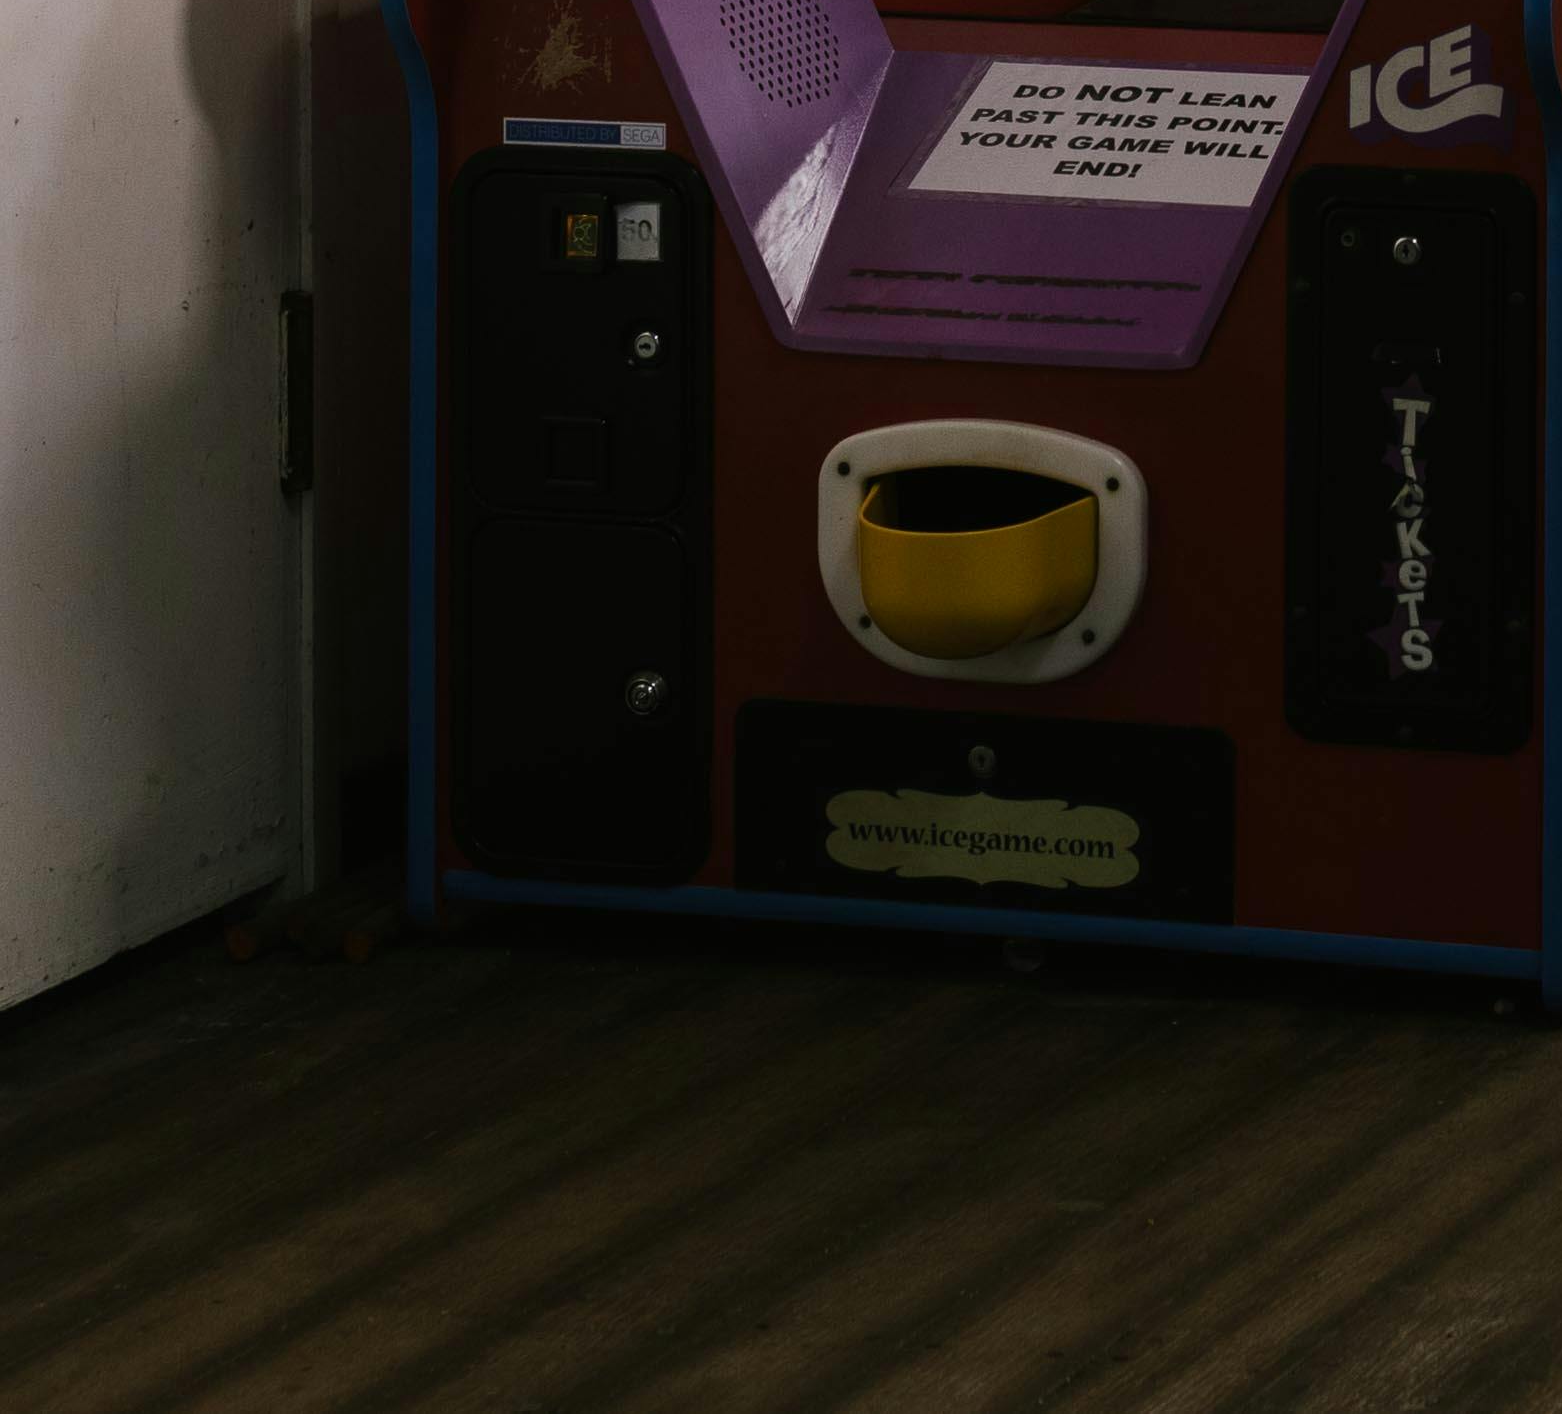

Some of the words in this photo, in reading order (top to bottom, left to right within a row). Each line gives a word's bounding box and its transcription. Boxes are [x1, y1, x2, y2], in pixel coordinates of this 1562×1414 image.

[1349, 23, 1504, 134] ICE
[1012, 84, 1065, 100] DO
[1075, 84, 1174, 104] NOT
[1178, 90, 1278, 109] LEAN
[509, 121, 596, 142] DISTRIBUTED
[600, 126, 617, 142] BY
[622, 127, 662, 144] SEGA
[969, 108, 1063, 124] PAST
[1075, 111, 1158, 130] THIS
[1167, 116, 1285, 135] POINT.
[959, 131, 1058, 150] YOUR
[1067, 135, 1175, 154] GAME
[1183, 139, 1270, 159] WILL
[1052, 160, 1142, 179] END!
[848, 821, 1116, 859] www.icegame.com
